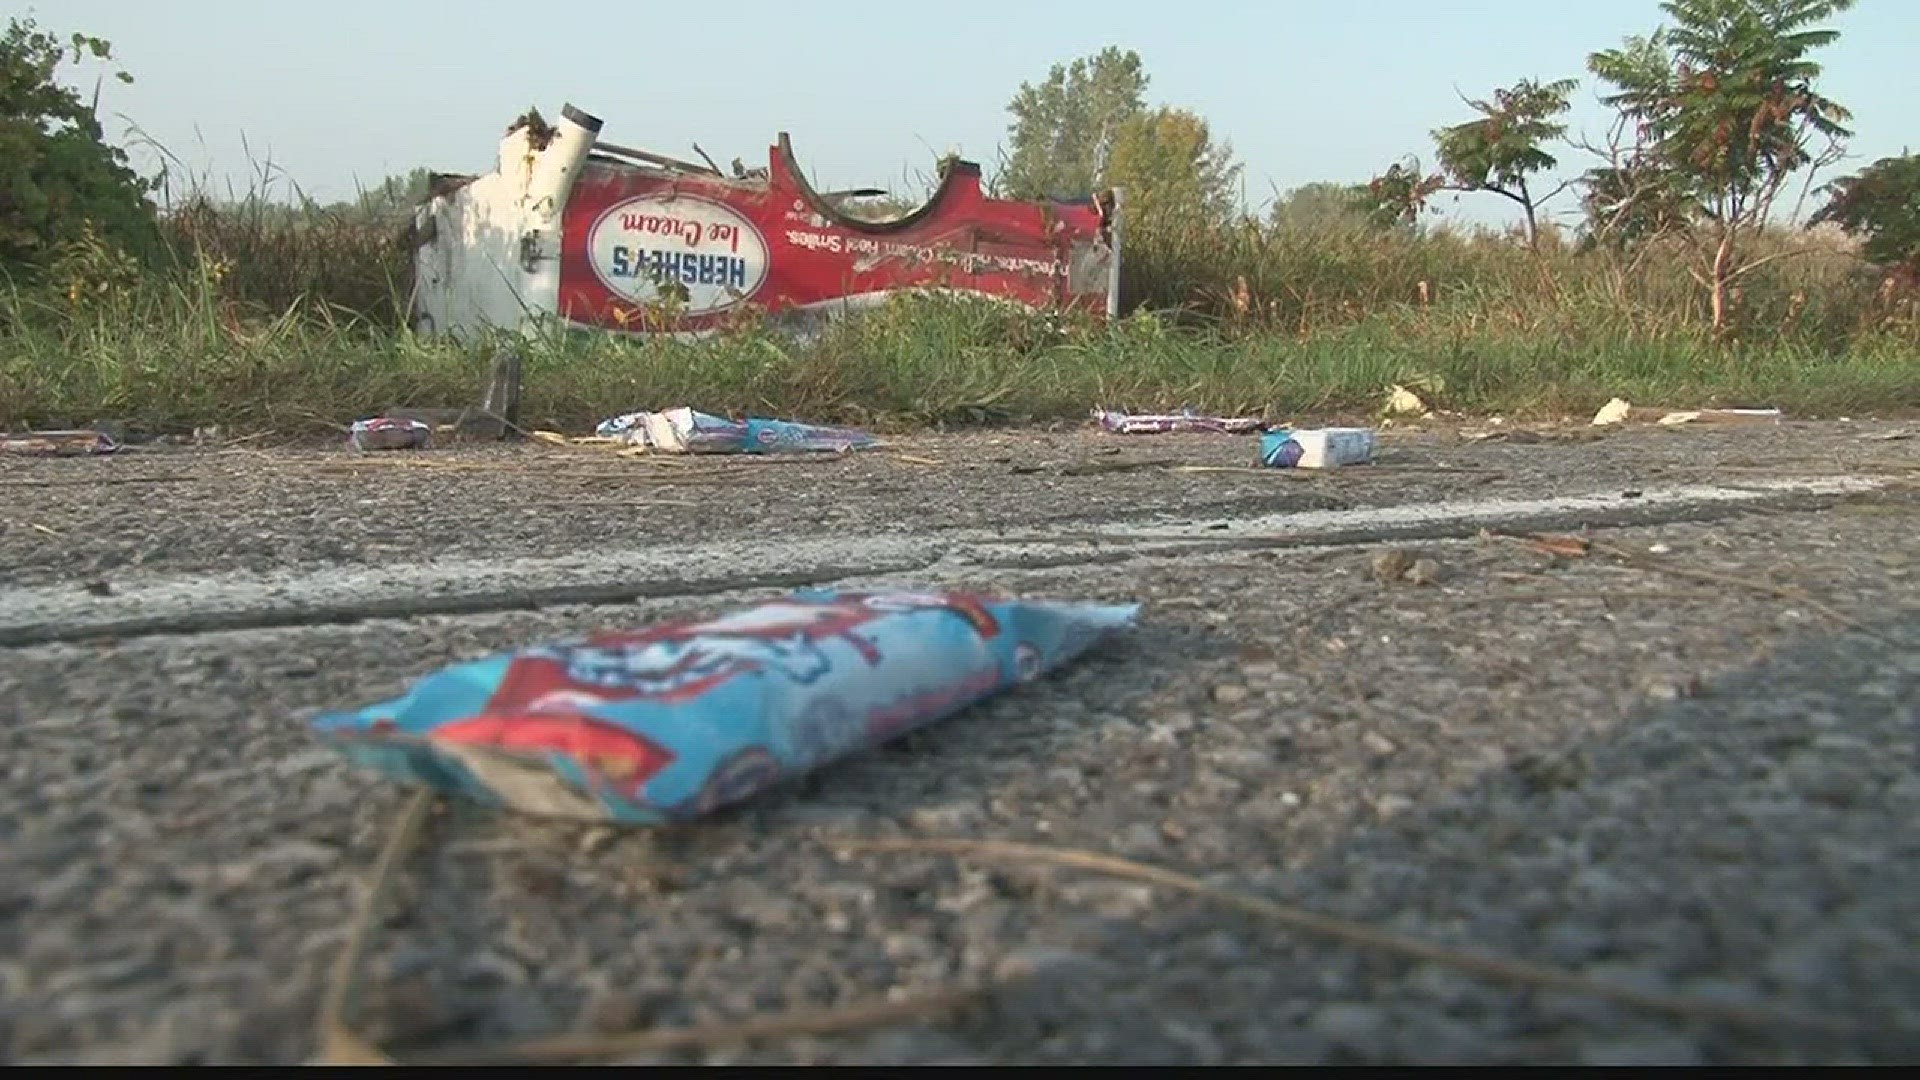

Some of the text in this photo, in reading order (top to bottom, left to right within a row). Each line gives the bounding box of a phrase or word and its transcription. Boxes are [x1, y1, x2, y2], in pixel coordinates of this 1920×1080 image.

[618, 214, 740, 254] Ice Cream
[785, 230, 842, 252] Smiles.
[845, 238, 879, 255] Real
[612, 246, 745, 288] HERSHEY'S
